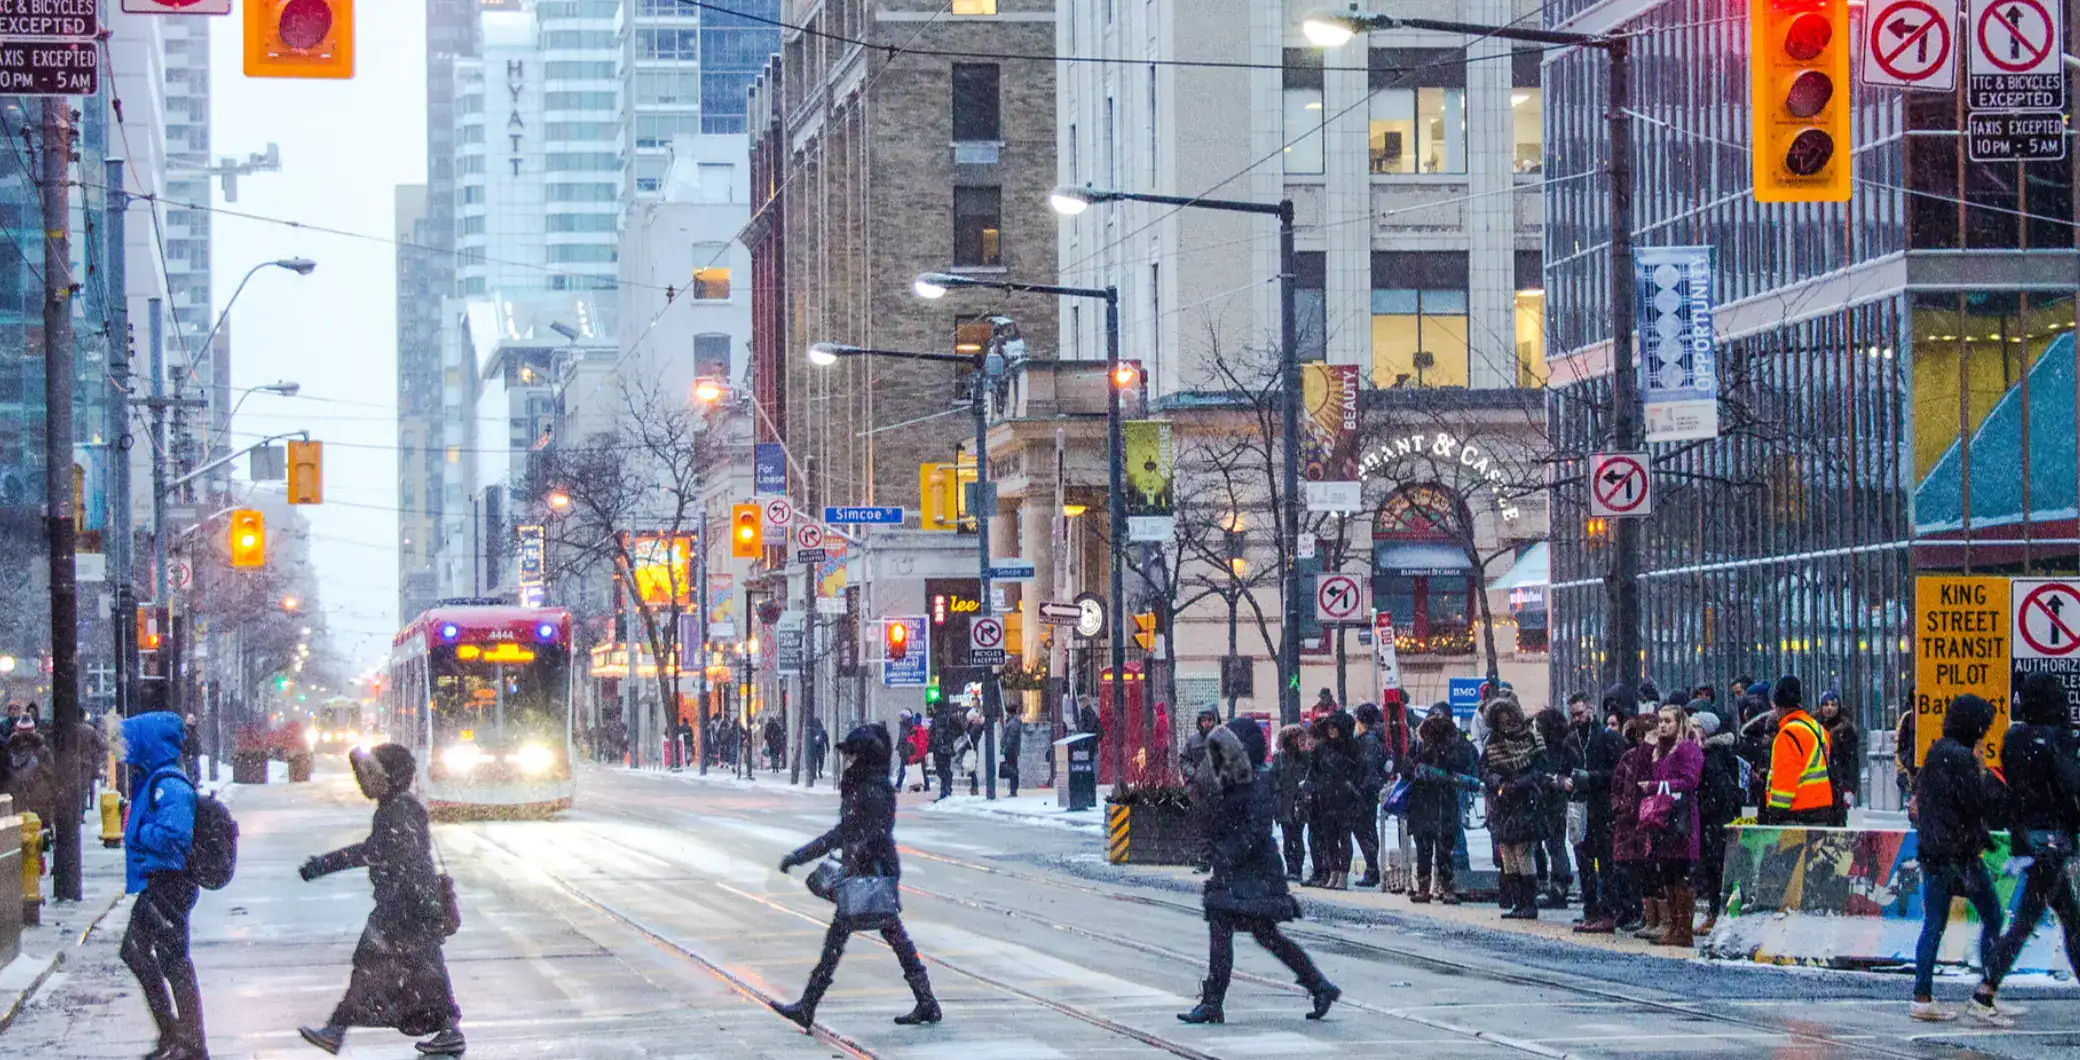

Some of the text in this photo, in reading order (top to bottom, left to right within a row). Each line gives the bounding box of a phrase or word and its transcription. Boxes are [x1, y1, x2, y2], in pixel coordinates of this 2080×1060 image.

[17, 0, 28, 14] &
[32, 0, 93, 14] BICYCLES
[0, 17, 85, 34] EXCEPTED
[33, 50, 95, 67] EXCEPTED
[1972, 75, 2060, 89] TTC & BICYCLES
[1980, 92, 2053, 106] EXCEPTED
[507, 59, 524, 176] HYATT
[1972, 120, 2061, 135] TAXIS EXCEPTED
[1691, 255, 1711, 391] OPPORTUNITY
[1343, 371, 1356, 430] BEAUTY
[1432, 433, 1455, 457] &
[757, 463, 774, 473] For
[757, 475, 785, 484] Lease
[836, 508, 882, 520] Simcoe
[1940, 584, 1986, 605] KING
[1927, 611, 2000, 632] STREET
[489, 630, 514, 639] 4444
[1923, 637, 2004, 659] TRANSIT
[2014, 659, 2080, 673] AUTHORIZ
[1936, 664, 1989, 685] PILOT
[1453, 687, 1476, 697] BMO
